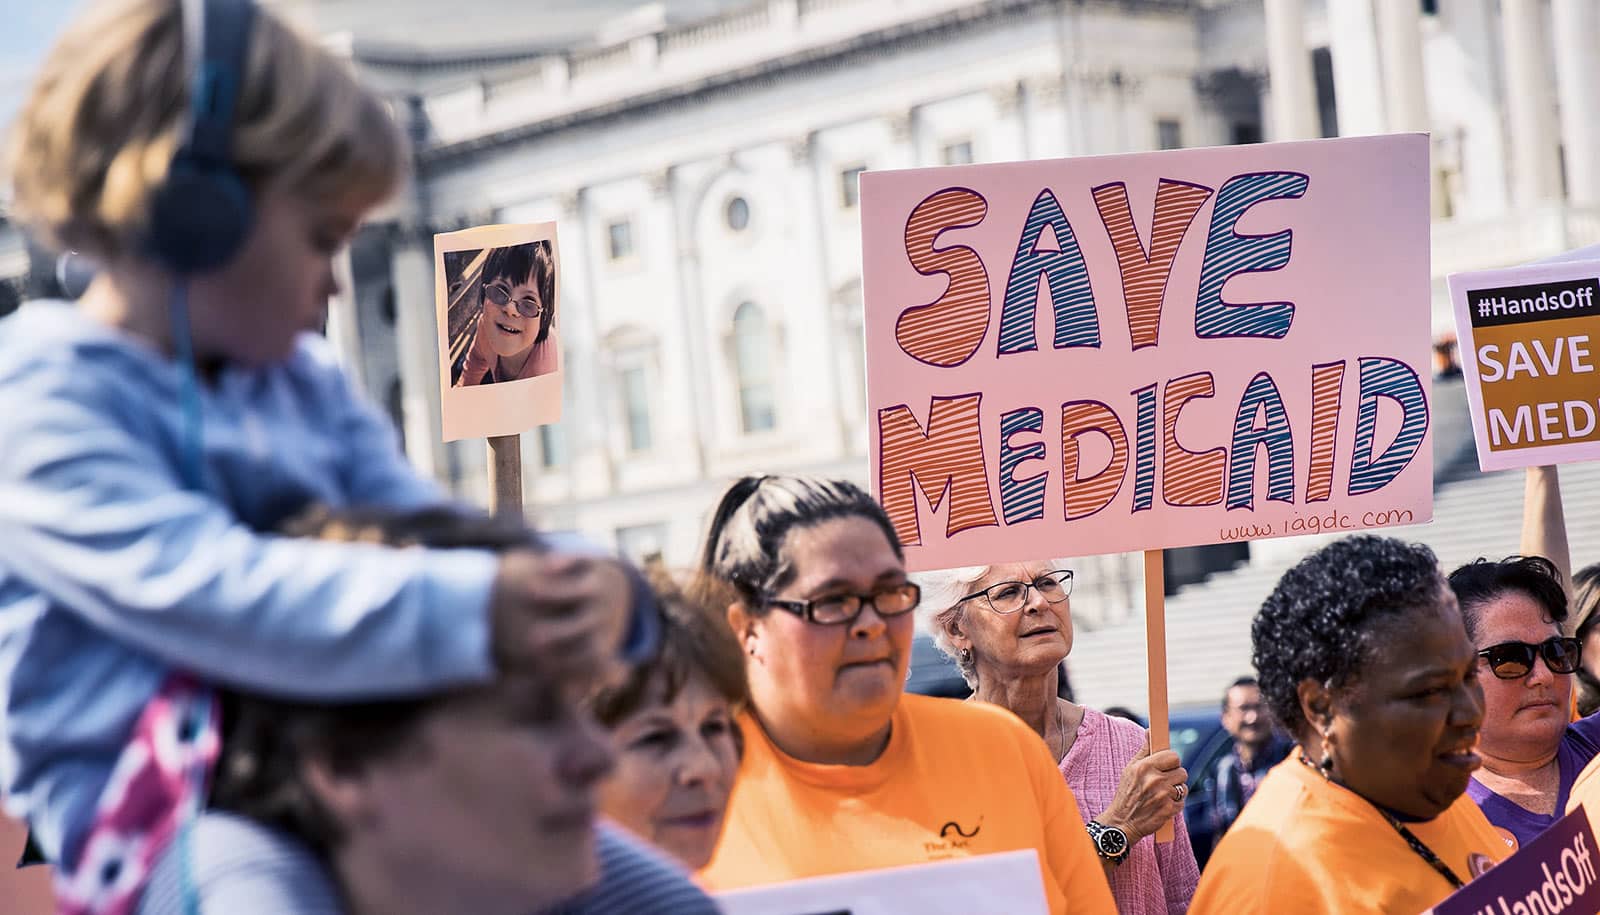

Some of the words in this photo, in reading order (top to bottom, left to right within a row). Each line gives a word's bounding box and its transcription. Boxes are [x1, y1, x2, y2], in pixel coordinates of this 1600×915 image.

[895, 171, 1310, 369] SAVE
[1477, 286, 1594, 318] #HandsOff
[1477, 335, 1594, 383] SAVE
[878, 356, 1430, 547] MEDICAID
[1487, 398, 1600, 446] MED
[1474, 831, 1597, 915] andsOff
